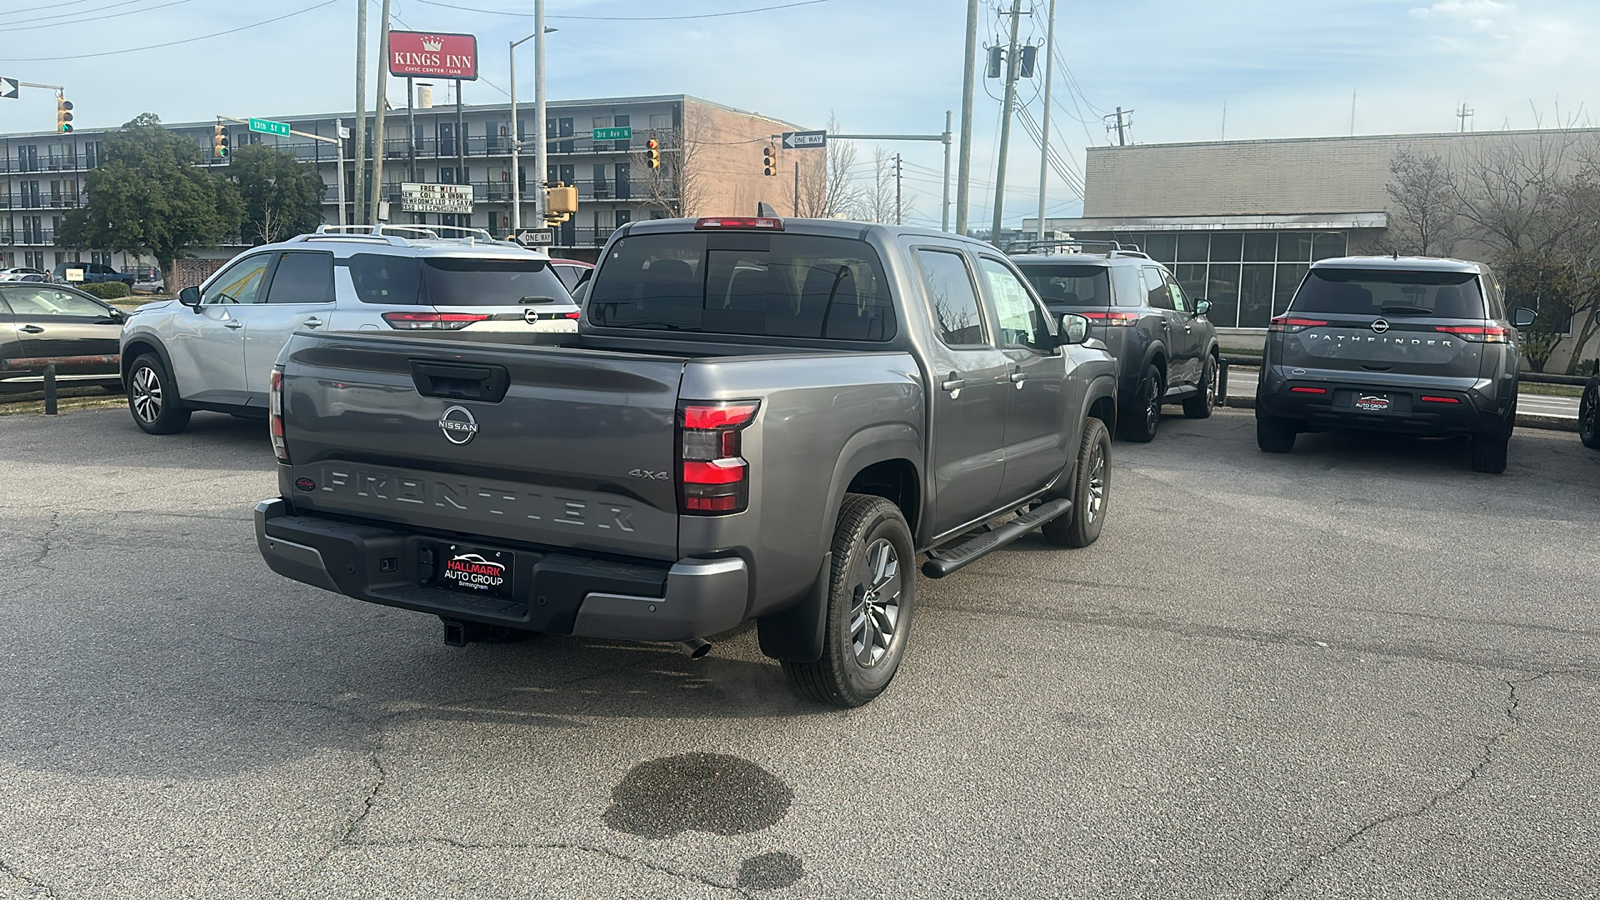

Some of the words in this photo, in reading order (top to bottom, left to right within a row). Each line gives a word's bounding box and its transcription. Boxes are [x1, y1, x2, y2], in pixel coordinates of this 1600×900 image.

[394, 52, 440, 66] KINGS
[446, 54, 471, 68] INN
[254, 122, 266, 130] 13th
[1310, 334, 1452, 347] PATHFINDER
[439, 420, 477, 432] NISSAN
[321, 467, 634, 532] FRONTIER
[448, 560, 500, 576] HALLMARK
[444, 570, 469, 580] AUTO
[471, 574, 503, 586] GROUP
[459, 580, 488, 590] Birmingham
